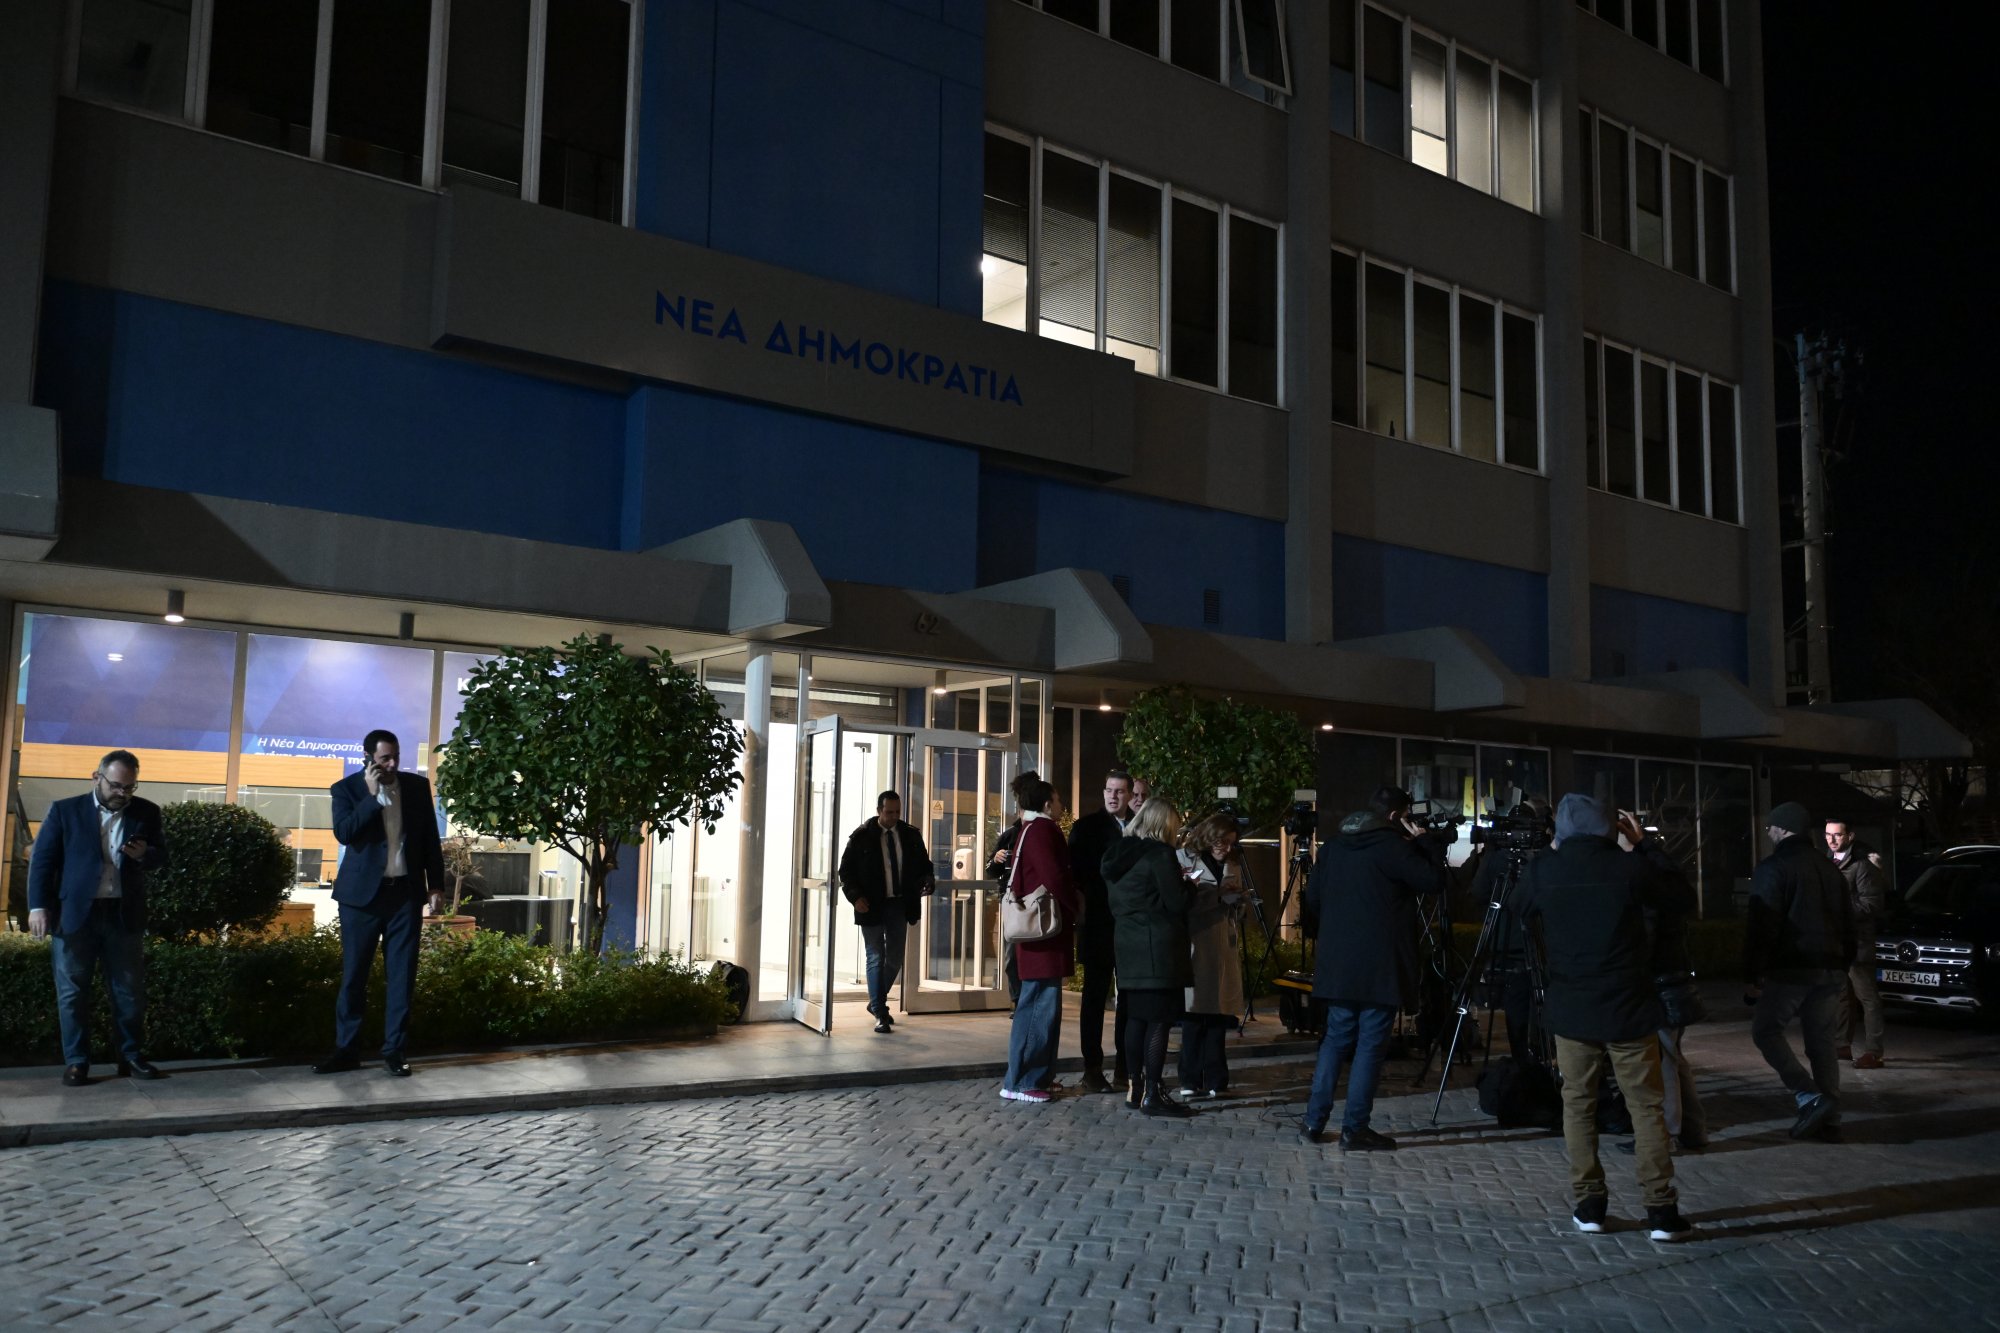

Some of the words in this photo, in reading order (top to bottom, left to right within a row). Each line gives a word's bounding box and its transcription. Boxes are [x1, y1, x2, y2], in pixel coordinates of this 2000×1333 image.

[655, 290, 747, 344] ΝΕΑ
[764, 319, 1023, 406] ΔΗΜΟΚΡΑΤΙΑ
[914, 611, 940, 636] 62
[258, 738, 268, 747] Η
[270, 738, 295, 749] Νέα
[297, 740, 364, 752] Δημοκρατία
